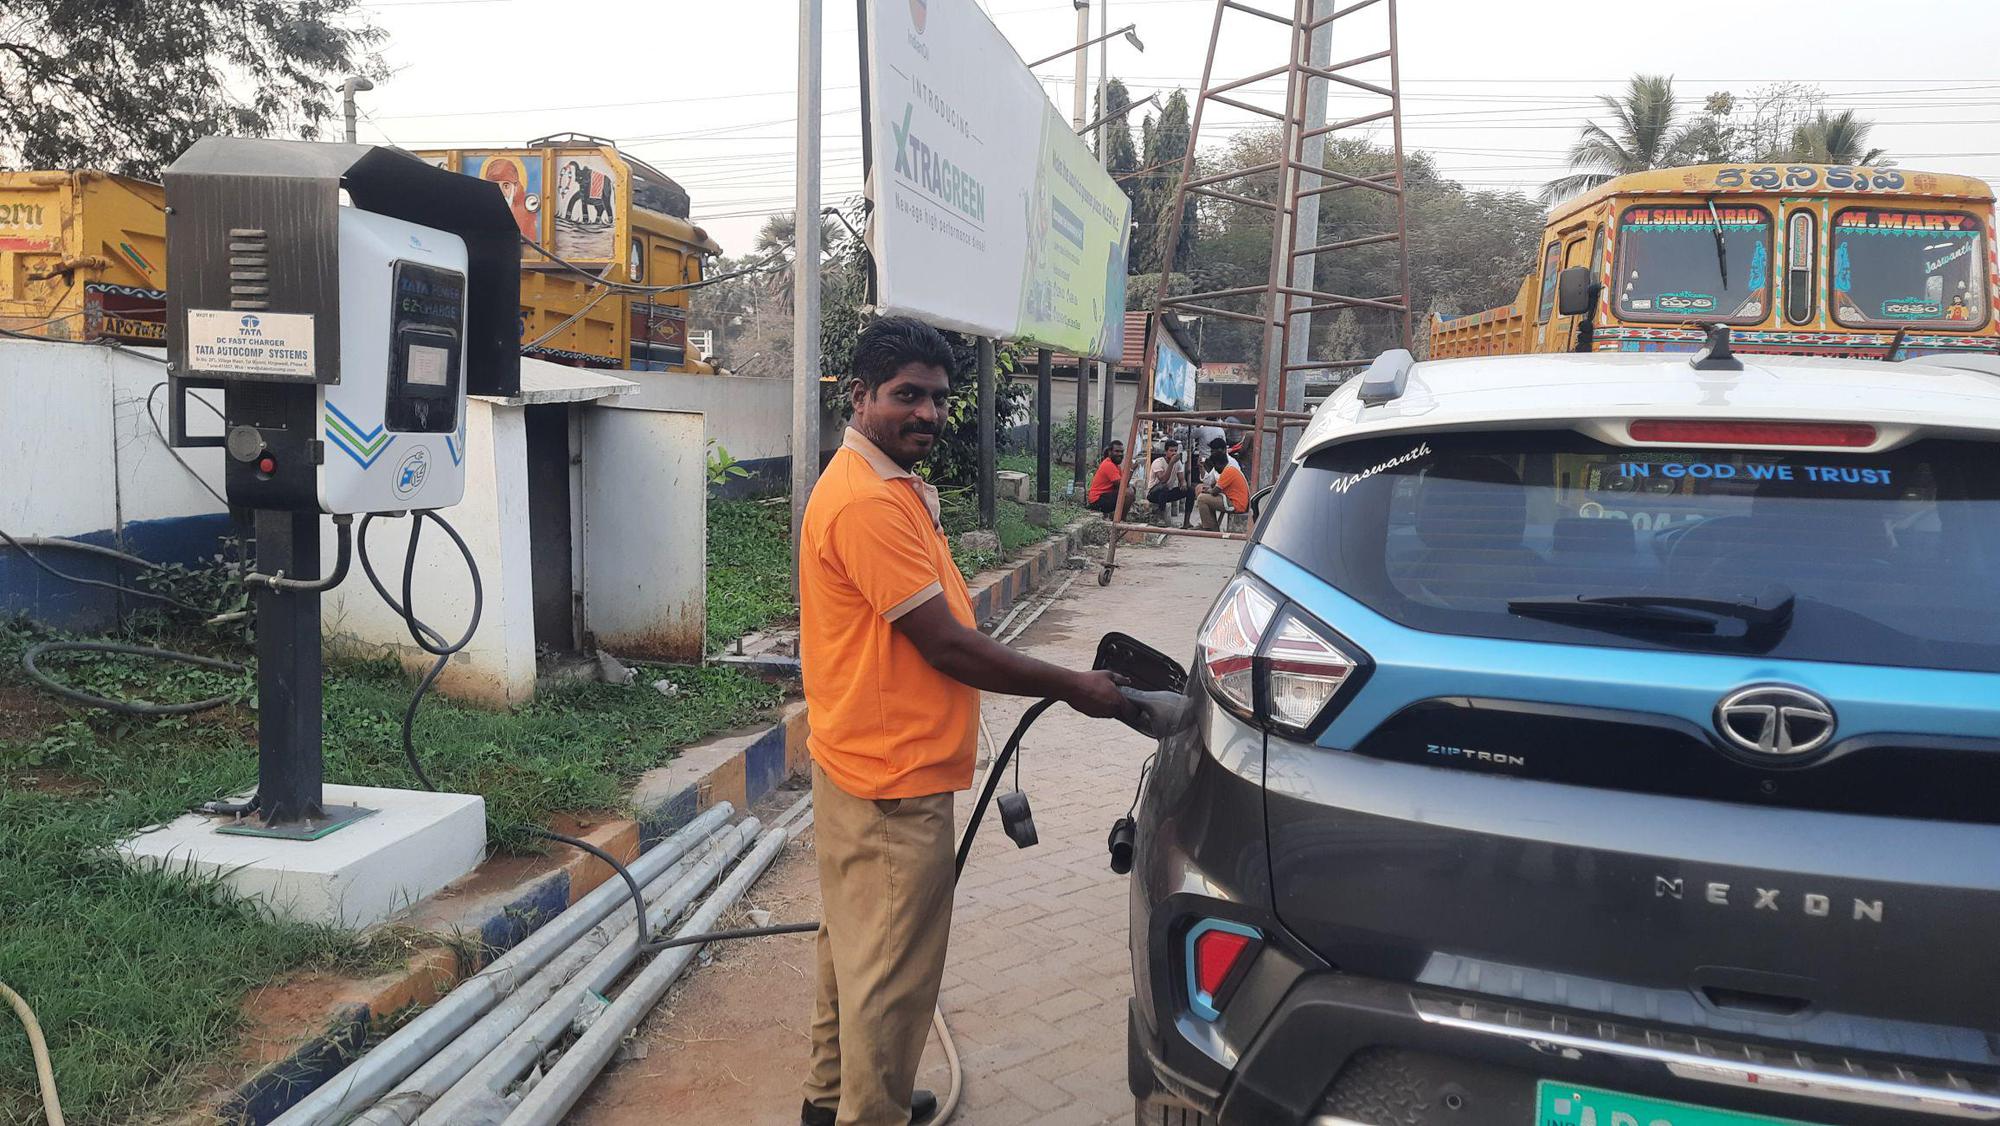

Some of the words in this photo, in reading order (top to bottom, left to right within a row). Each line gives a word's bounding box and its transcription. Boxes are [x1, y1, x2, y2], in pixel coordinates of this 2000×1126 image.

[912, 74, 969, 138] INTRODUCING
[892, 102, 985, 223] XTRAGREEN
[1825, 165, 1906, 192] కృప
[239, 328, 262, 336] TATA
[195, 345, 215, 355] TATA
[217, 346, 264, 357] AUTOCOMP
[268, 349, 308, 360] SYSTEMS
[1330, 442, 1432, 494] Yaswanth
[1620, 463, 1648, 478] IN
[1662, 463, 1736, 479] GOD
[1748, 465, 1795, 481] WE
[1804, 466, 1892, 485] TRUST
[1426, 744, 1525, 766] ZIPTRON
[1654, 875, 1884, 923] NEXON
